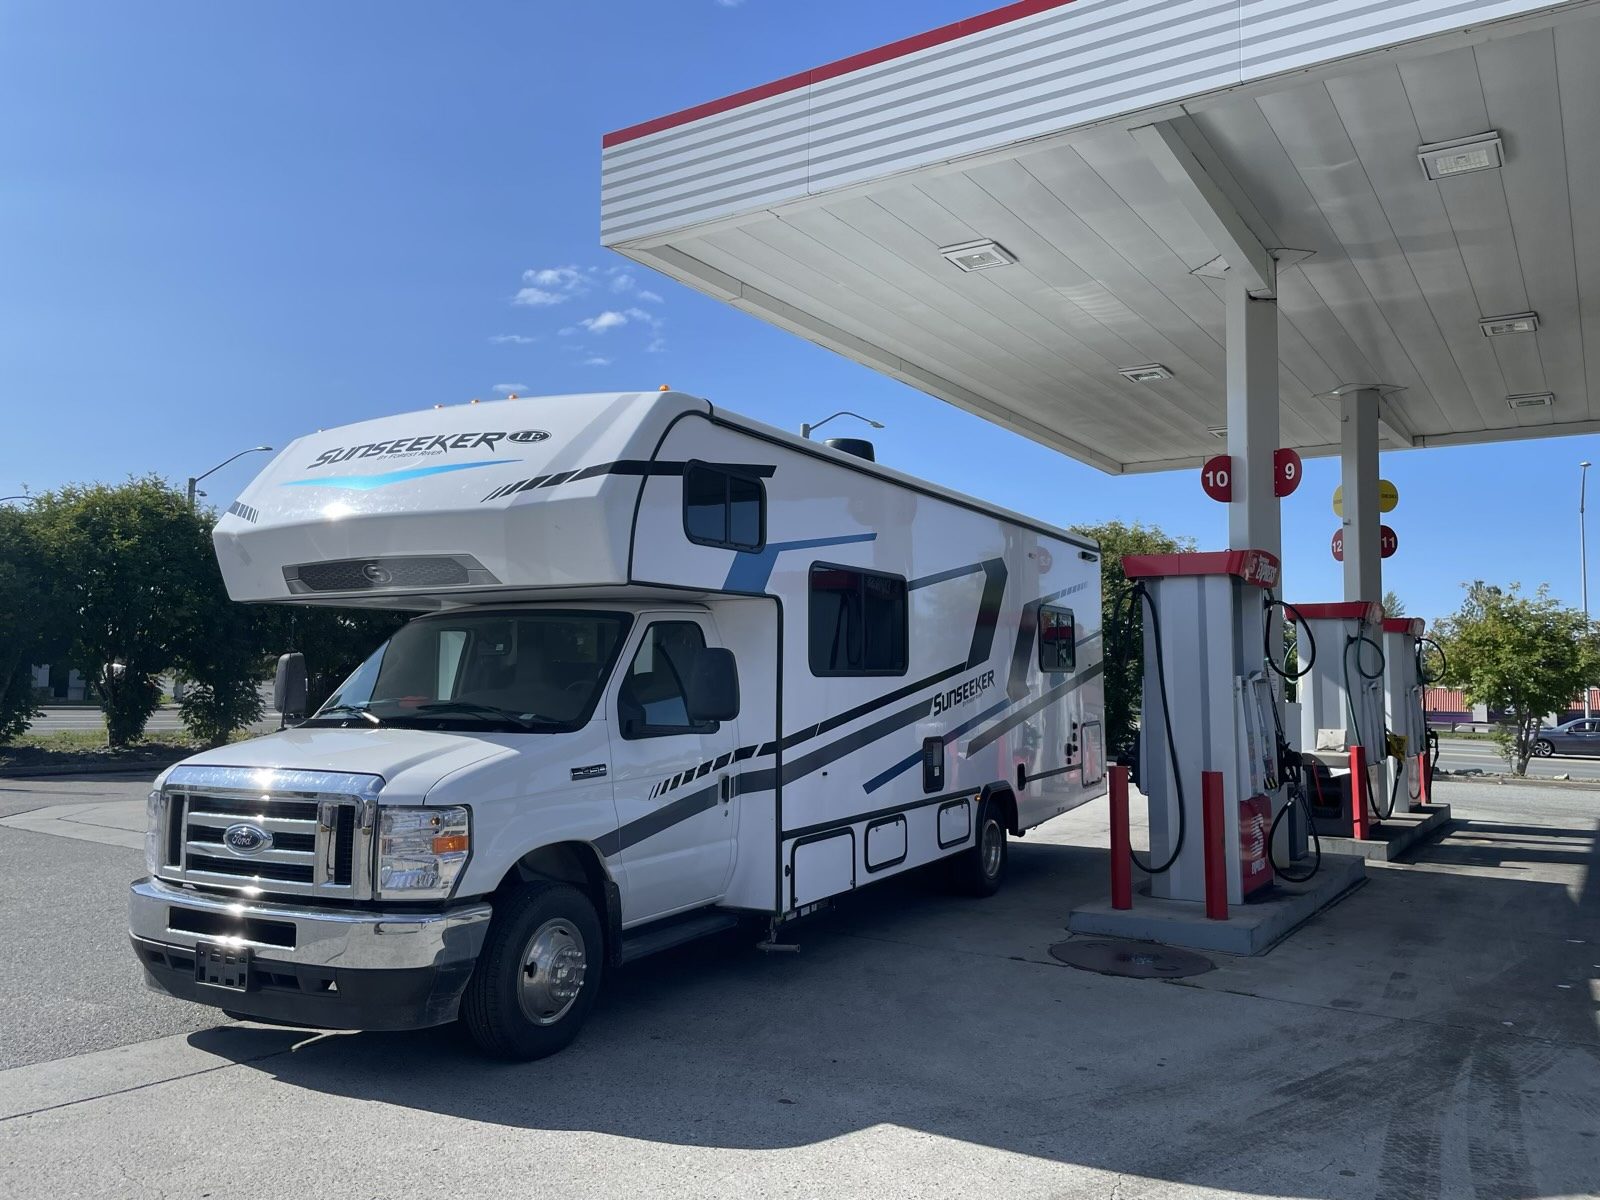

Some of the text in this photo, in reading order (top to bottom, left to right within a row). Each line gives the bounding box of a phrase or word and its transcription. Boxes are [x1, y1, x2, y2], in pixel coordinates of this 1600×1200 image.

[306, 431, 508, 469] SUNSEEKER
[389, 451, 418, 460] FOREST
[1205, 470, 1229, 487] 10
[1284, 462, 1295, 480] 9
[1332, 539, 1343, 553] 12
[1381, 536, 1396, 549] 11
[933, 669, 996, 717] SUNSEEKER
[231, 831, 253, 846] Ford
